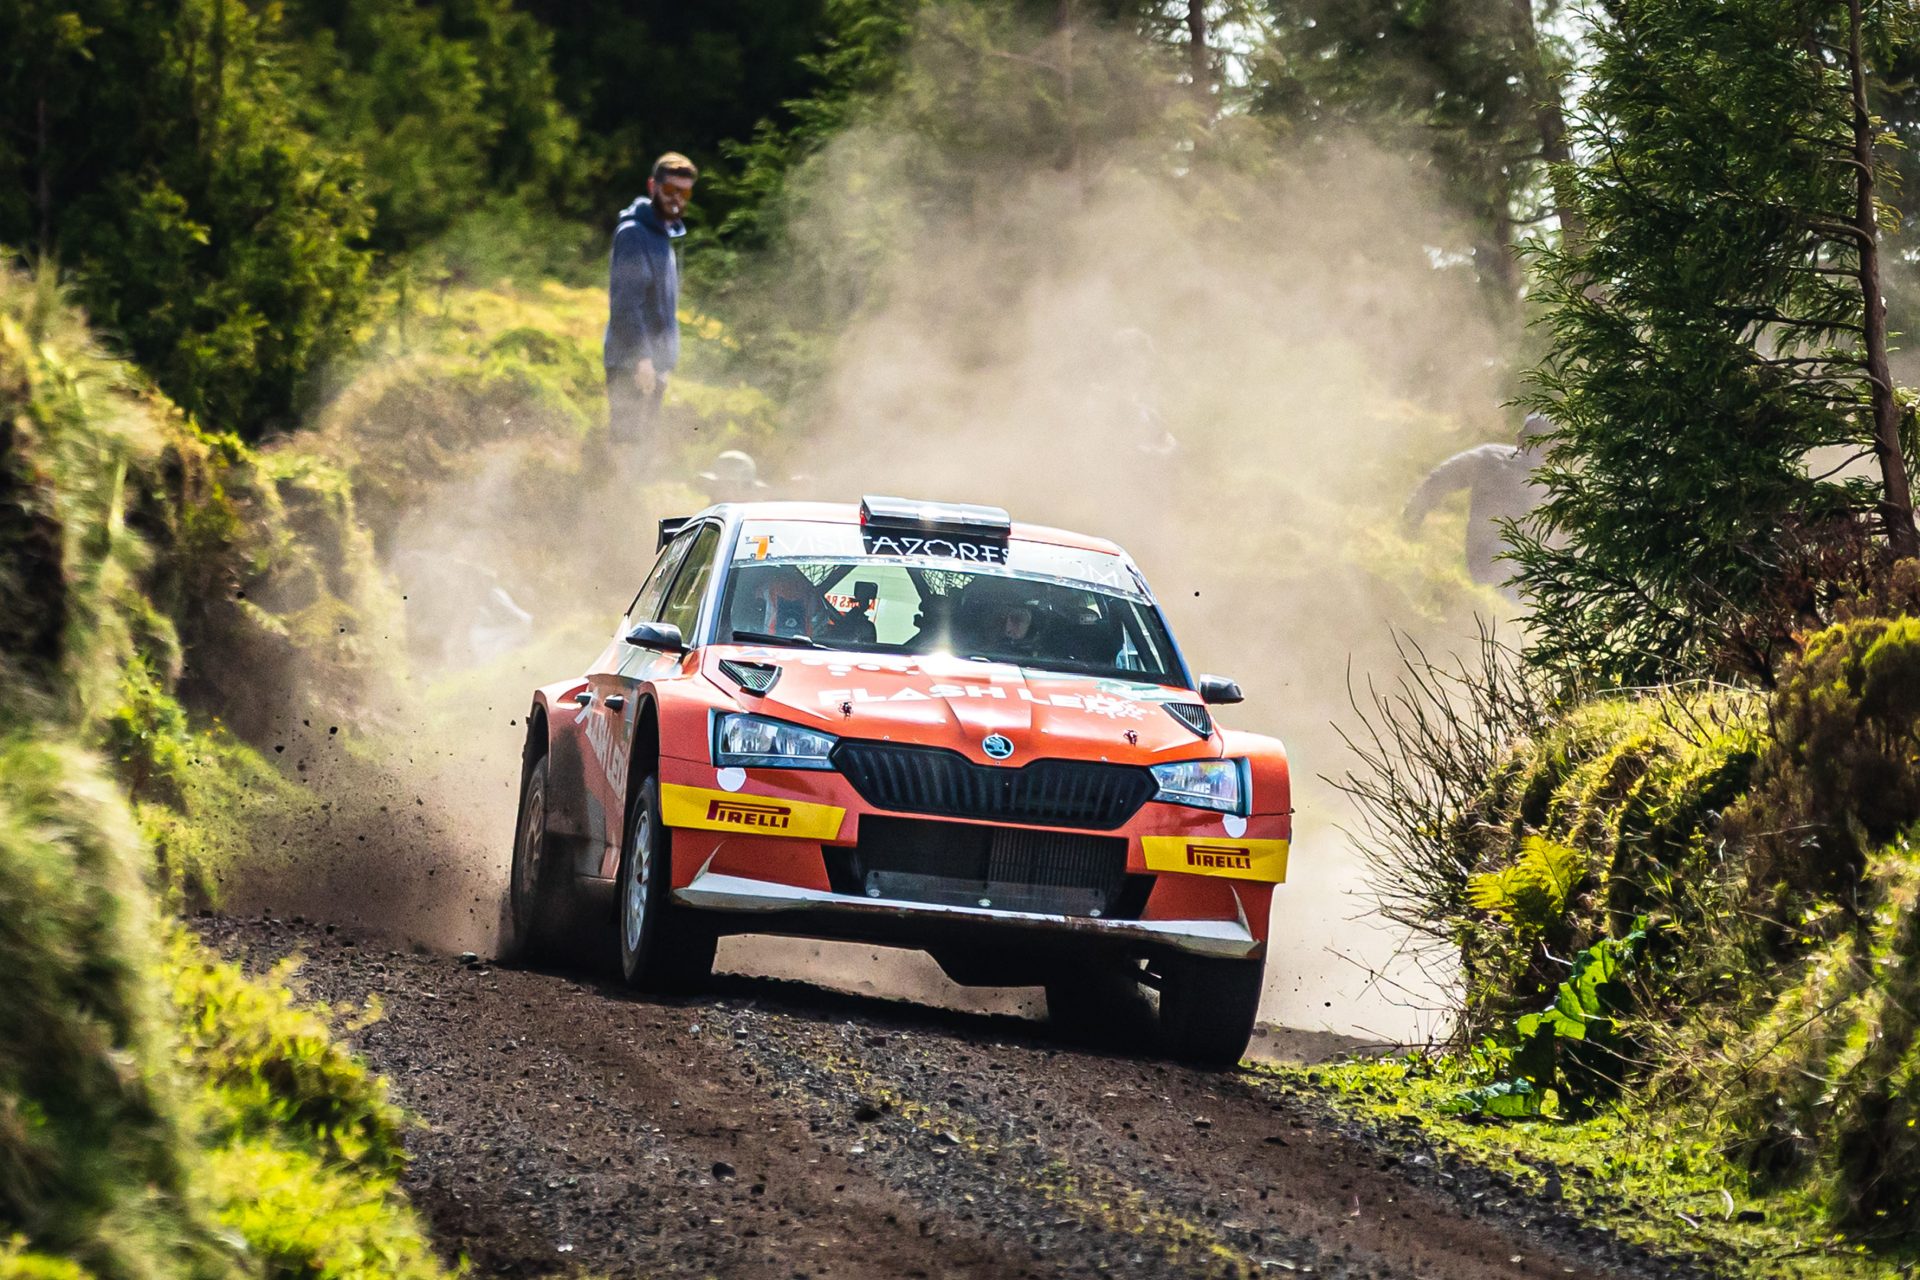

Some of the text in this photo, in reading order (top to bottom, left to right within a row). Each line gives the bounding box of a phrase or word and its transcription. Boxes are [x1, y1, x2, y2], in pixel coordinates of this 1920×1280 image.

[817, 684, 1007, 708] FLASH
[706, 800, 791, 828] PIRELLI
[1186, 844, 1251, 869] PIRELLI
